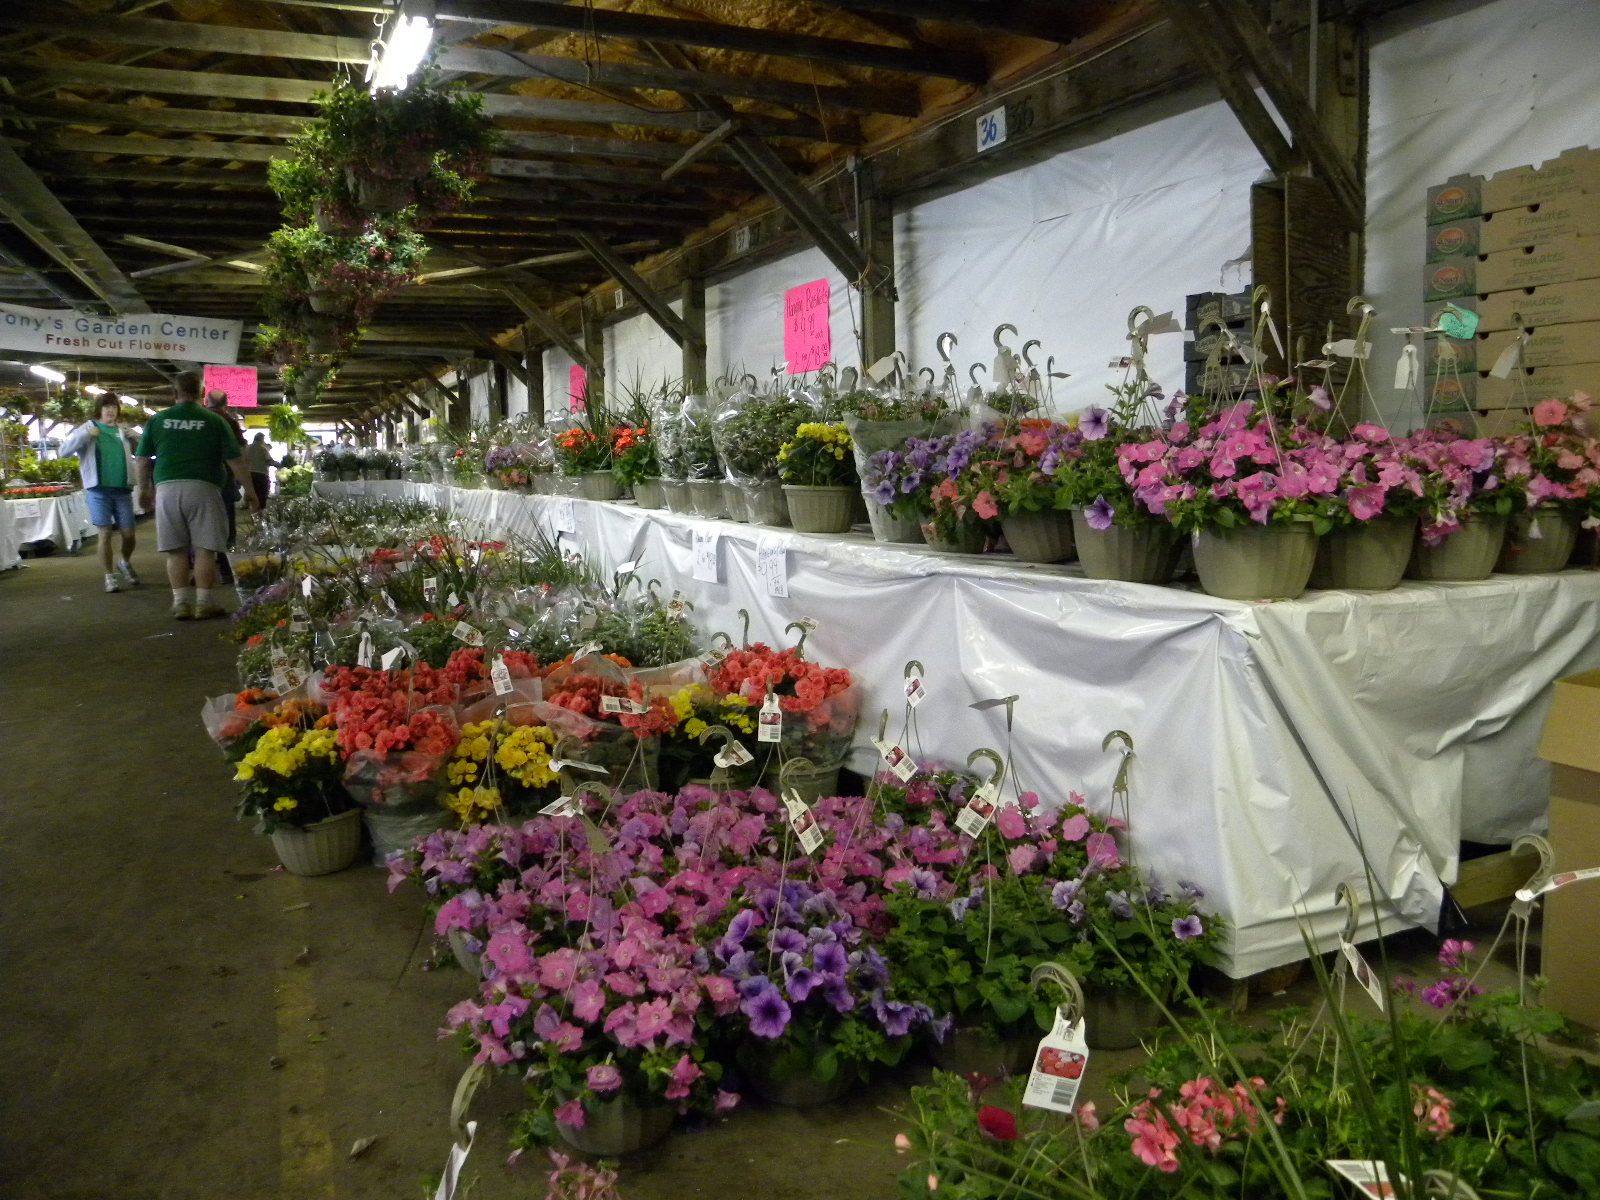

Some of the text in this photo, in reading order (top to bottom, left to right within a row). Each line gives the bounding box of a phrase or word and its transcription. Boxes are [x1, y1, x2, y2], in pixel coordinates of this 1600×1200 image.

[981, 115, 997, 146] 36
[0, 313, 230, 341] ony's Garden Center
[45, 334, 187, 352] Fresh Cut Flowers
[163, 418, 205, 430] STAFF
